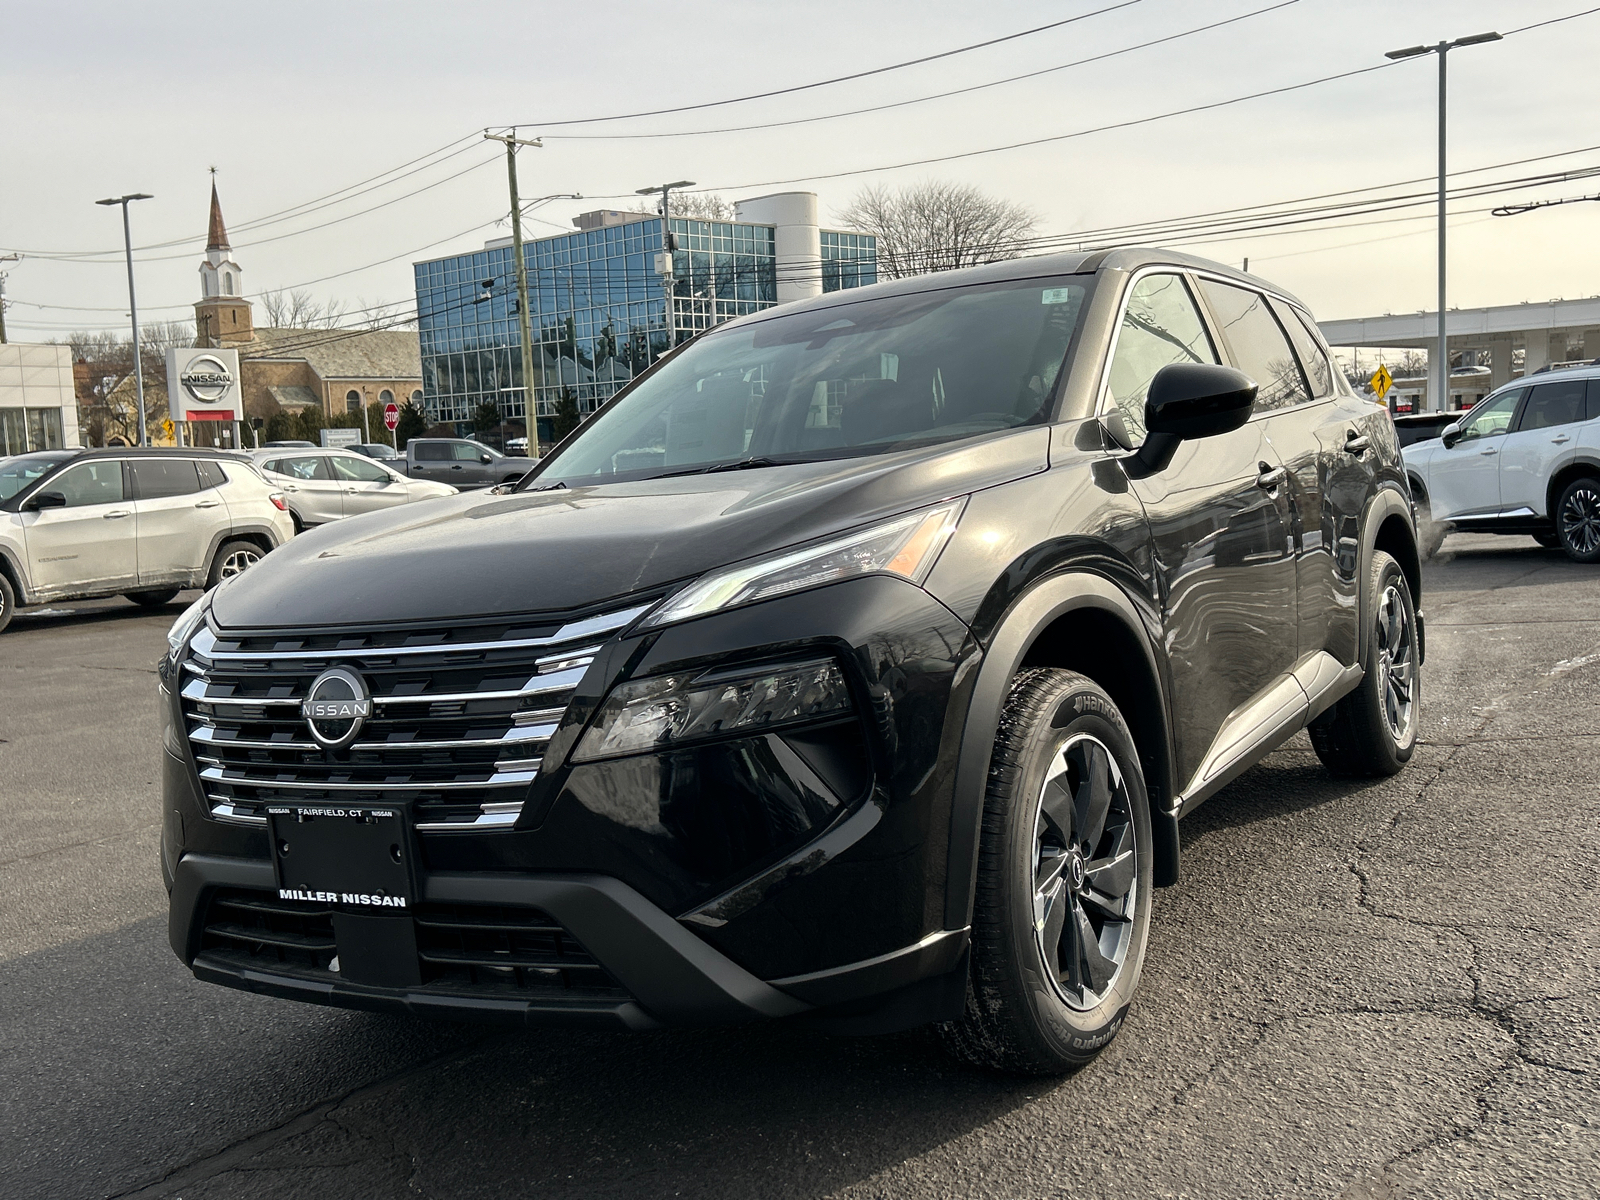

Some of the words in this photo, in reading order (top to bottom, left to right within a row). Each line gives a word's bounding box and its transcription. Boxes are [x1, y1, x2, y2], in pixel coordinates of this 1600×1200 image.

[187, 374, 231, 383] NISSAN
[385, 411, 399, 422] STOP
[302, 703, 367, 716] NISSAN
[298, 808, 348, 818] FAIRFIELD,
[349, 809, 362, 817] CT
[279, 889, 338, 902] MILLER
[341, 893, 406, 907] NISSAN
